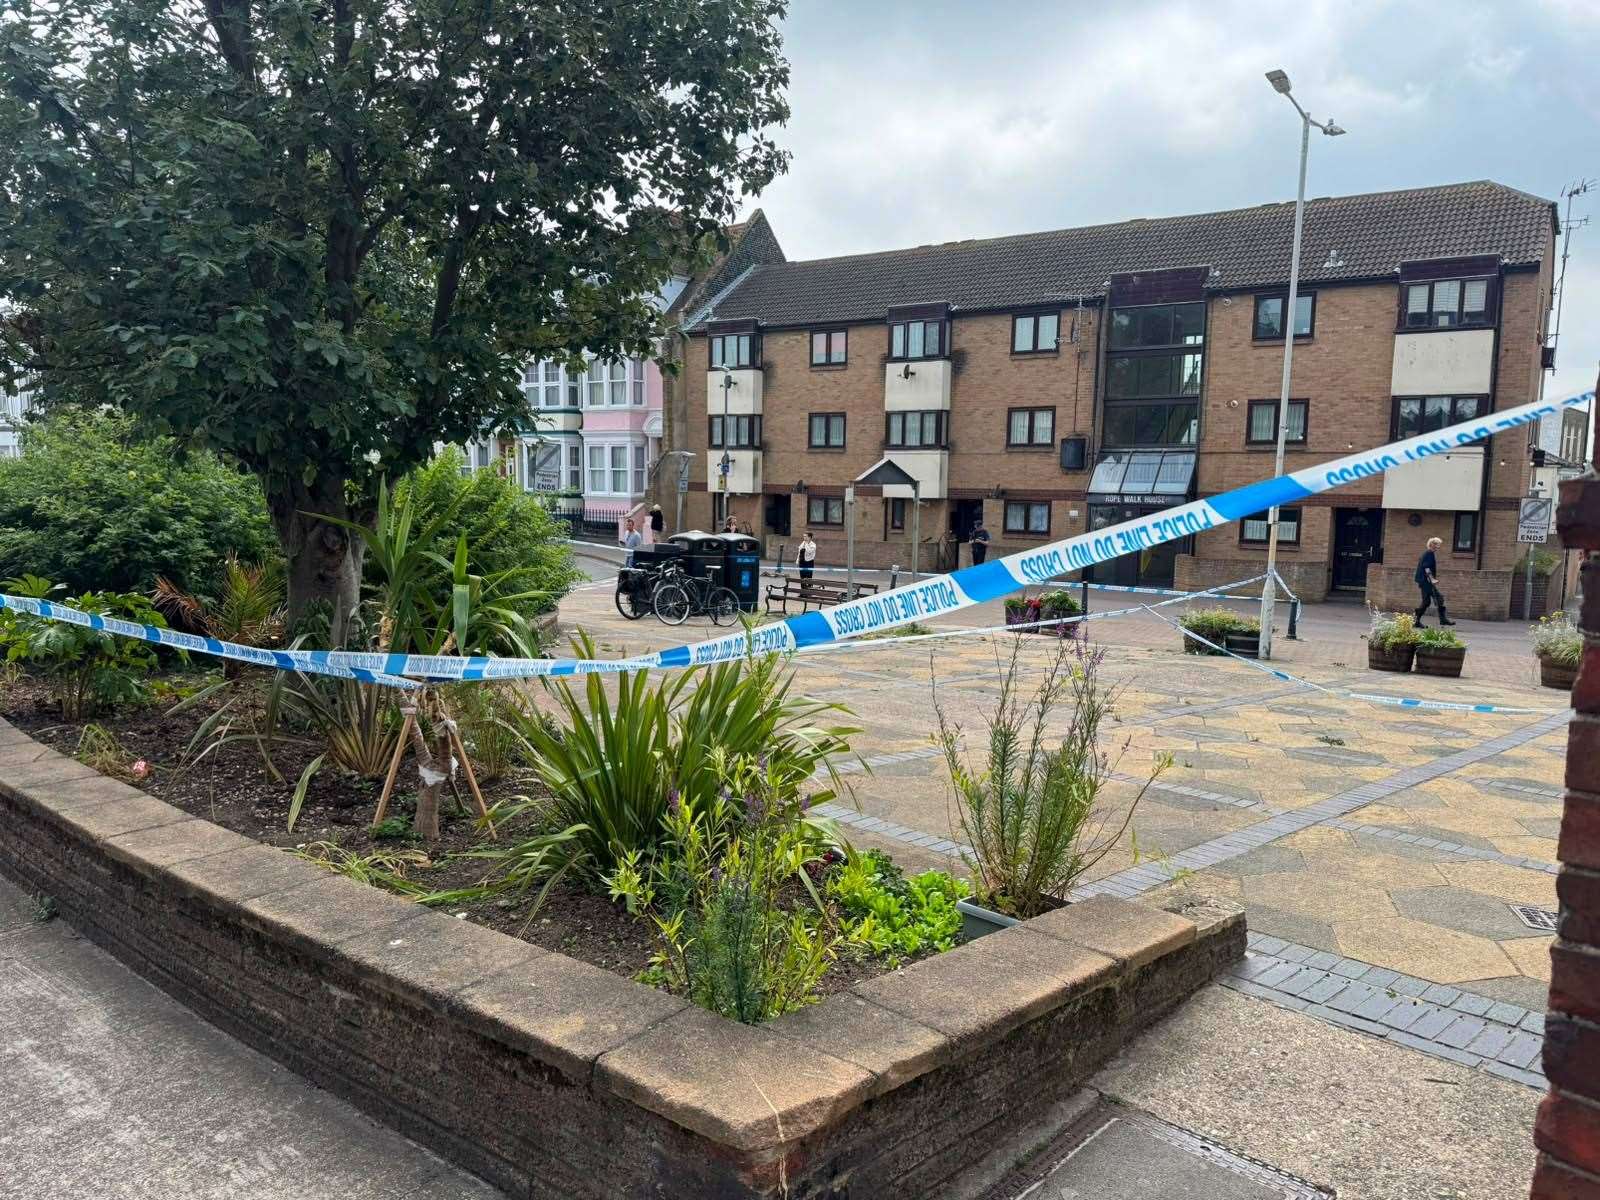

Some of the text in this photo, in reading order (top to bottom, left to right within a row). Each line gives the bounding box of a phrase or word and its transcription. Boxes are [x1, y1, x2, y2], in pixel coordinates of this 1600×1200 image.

[1105, 495, 1121, 503] ROPE
[1123, 495, 1142, 503] WALK
[1116, 525, 1153, 552] LINE
[1152, 508, 1214, 541] POLICE
[1020, 549, 1065, 585] CROSS
[833, 580, 960, 636] POLICE LINE DO NOT CROSS
[761, 625, 787, 652] POLICE
